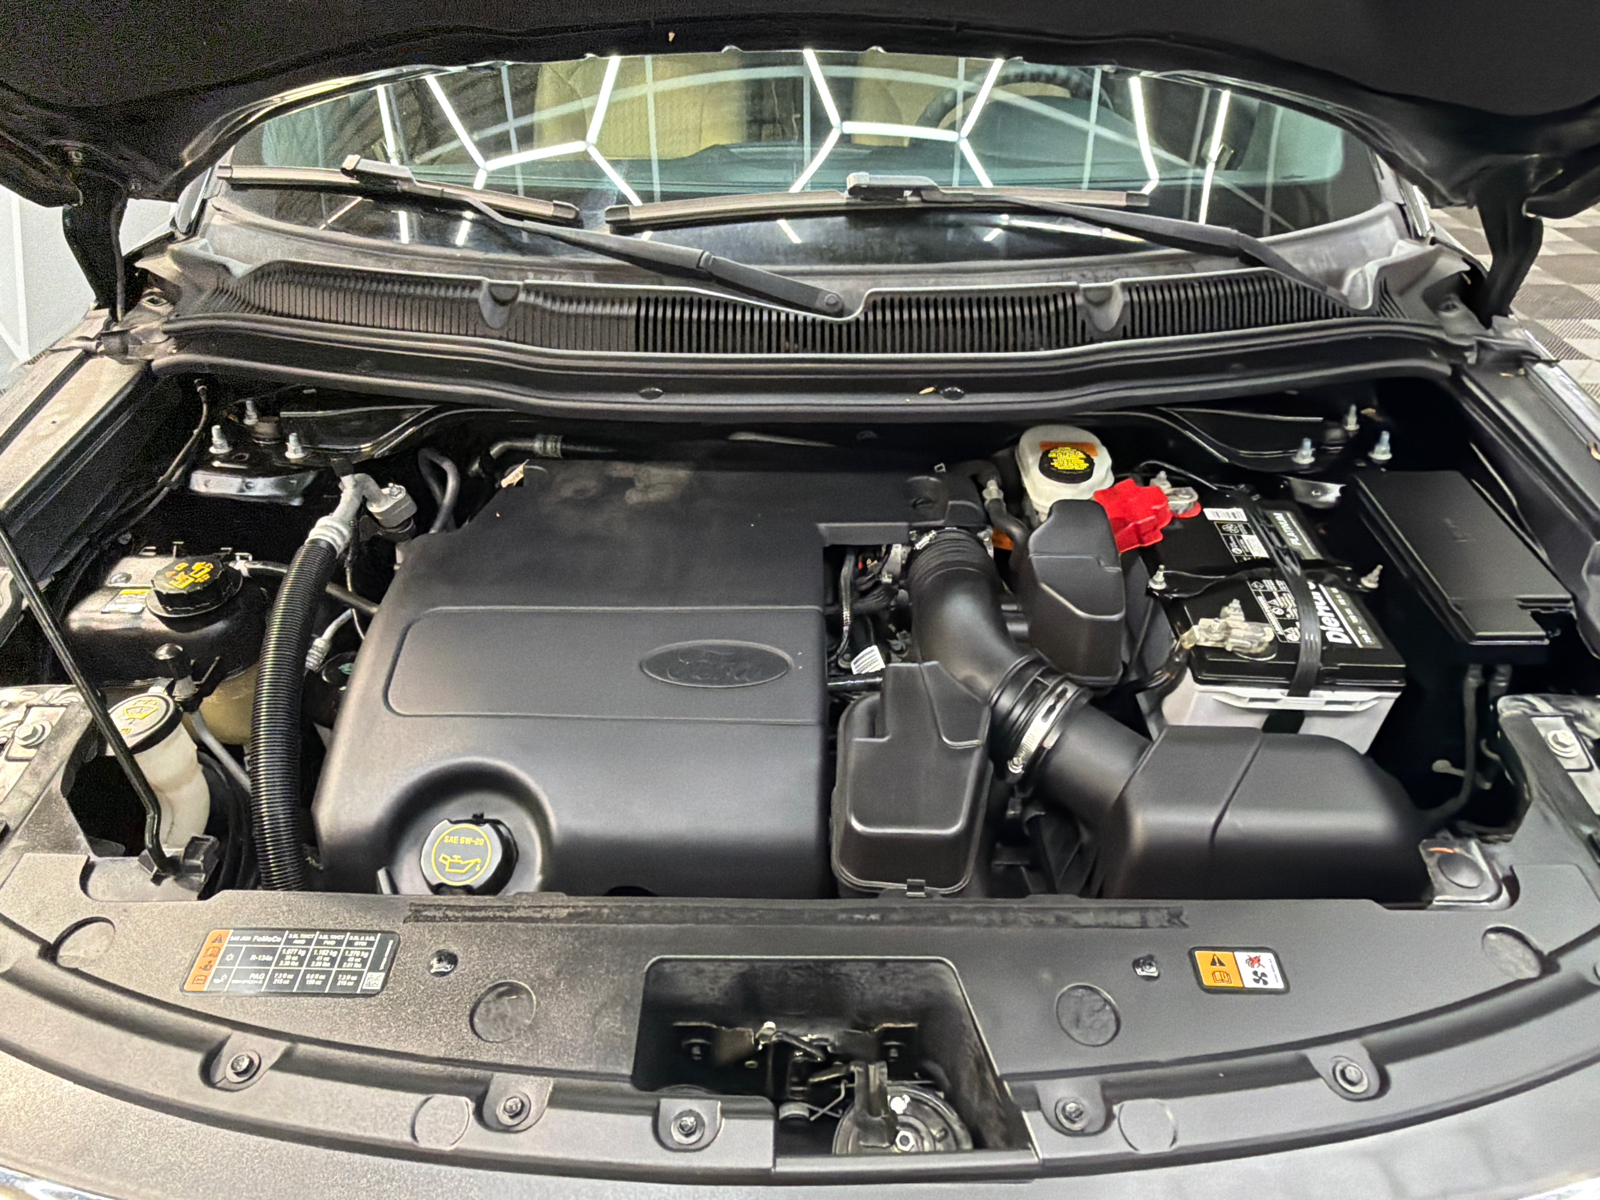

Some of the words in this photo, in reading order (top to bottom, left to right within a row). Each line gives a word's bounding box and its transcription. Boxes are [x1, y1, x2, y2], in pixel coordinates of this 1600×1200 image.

[1273, 512, 1302, 546] PLATINUM
[444, 835, 458, 844] SAE
[460, 836, 485, 846] 5W-20
[252, 935, 282, 943] FoMoCo
